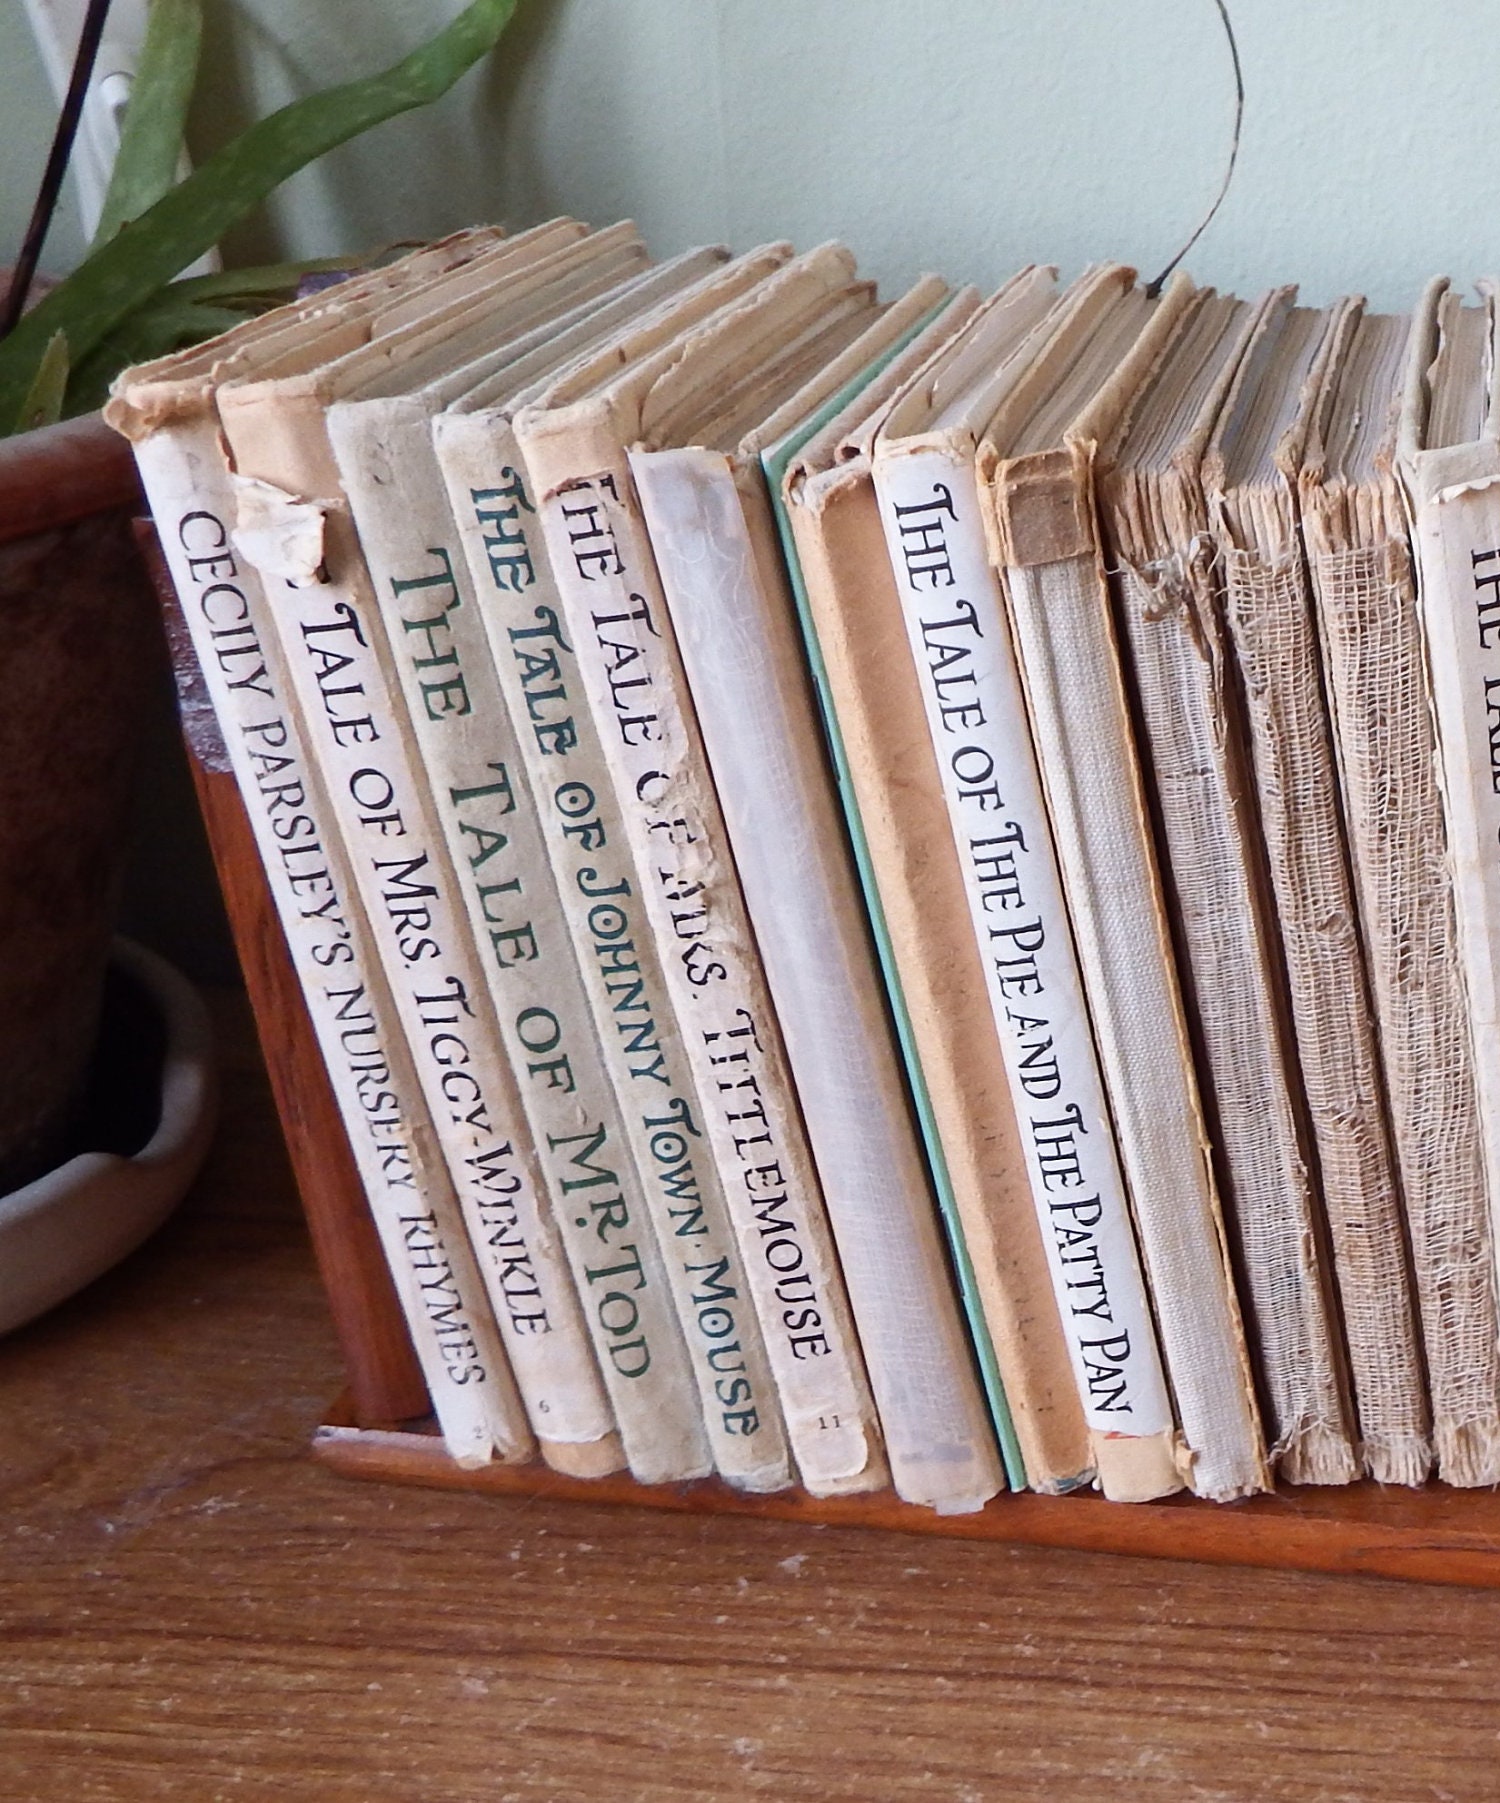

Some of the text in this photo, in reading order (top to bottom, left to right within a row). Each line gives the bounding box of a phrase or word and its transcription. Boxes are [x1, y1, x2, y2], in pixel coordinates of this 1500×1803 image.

[470, 466, 536, 594] THE
[508, 605, 578, 757] TALE
[554, 781, 606, 851] OF
[178, 511, 486, 1385] CECILY PARSLEY'S NURSERY RHYMES
[300, 602, 553, 1336] TALE OF MRS. TIGGY-WINKLE
[389, 547, 472, 722] THE
[450, 762, 540, 968] TALE
[515, 1006, 576, 1095] OF
[584, 1244, 651, 1378] TOD
[577, 867, 672, 1087] JOHNNY
[592, 593, 664, 746] TALE
[703, 1008, 832, 1362] TITTLEMOUSE
[893, 483, 1133, 1415] THE TALE OF THE PIE AND THE PATTY PAN
[538, 1399, 551, 1414] 6
[685, 1256, 760, 1437] MOUSE
[818, 1414, 841, 1430] 11
